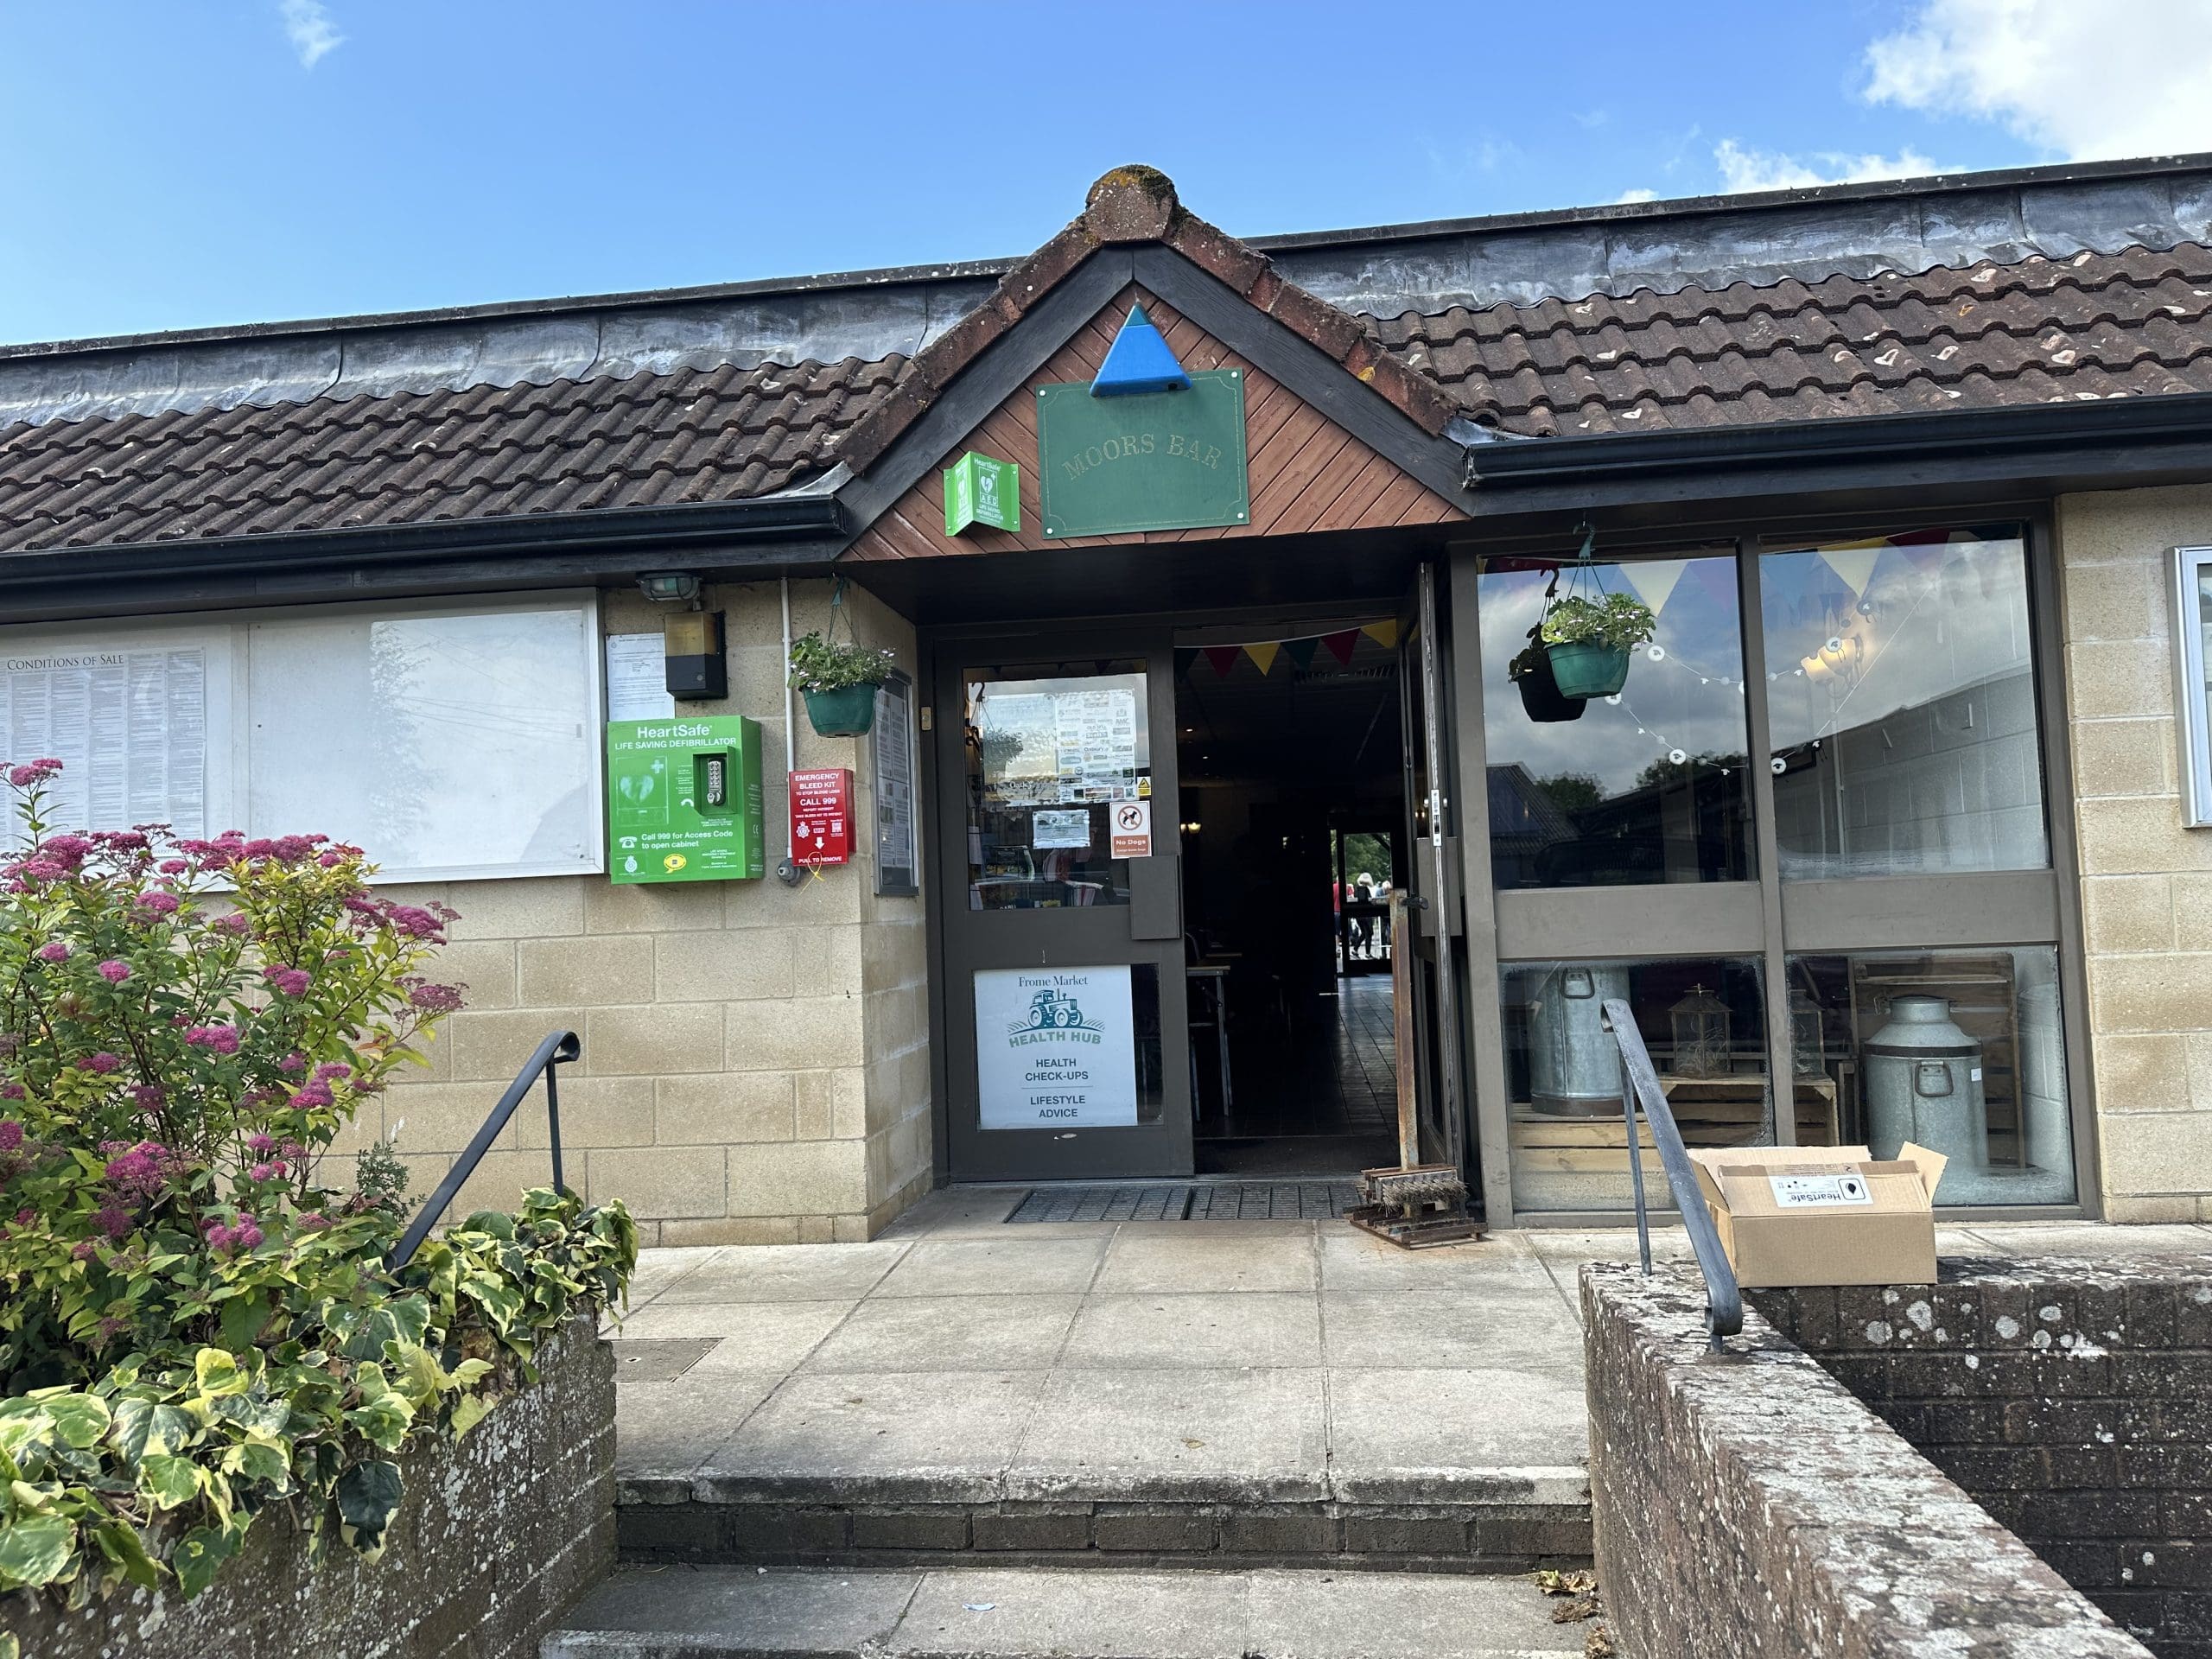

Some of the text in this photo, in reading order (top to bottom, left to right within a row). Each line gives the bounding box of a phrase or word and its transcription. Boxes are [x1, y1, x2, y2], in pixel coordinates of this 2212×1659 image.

[1062, 433, 1222, 480] MOORS BAR
[974, 457, 1001, 471] HeartSafe
[981, 494, 997, 505] AED
[638, 724, 711, 738] HeartSafe
[635, 741, 667, 749] SAVING
[670, 737, 736, 747] DEFIBRILLATOR
[800, 798, 821, 806] CALL
[1019, 975, 1089, 987] Frome Market
[1008, 1032, 1102, 1048] HEALTH HUB
[1036, 1058, 1077, 1067] HEALTH
[1025, 1071, 1089, 1081] CHECK-UPS
[1030, 1095, 1085, 1105] LIFESTYLE
[1039, 1109, 1078, 1118] ADVICE
[1790, 1193, 1841, 1202] HeartSafe
